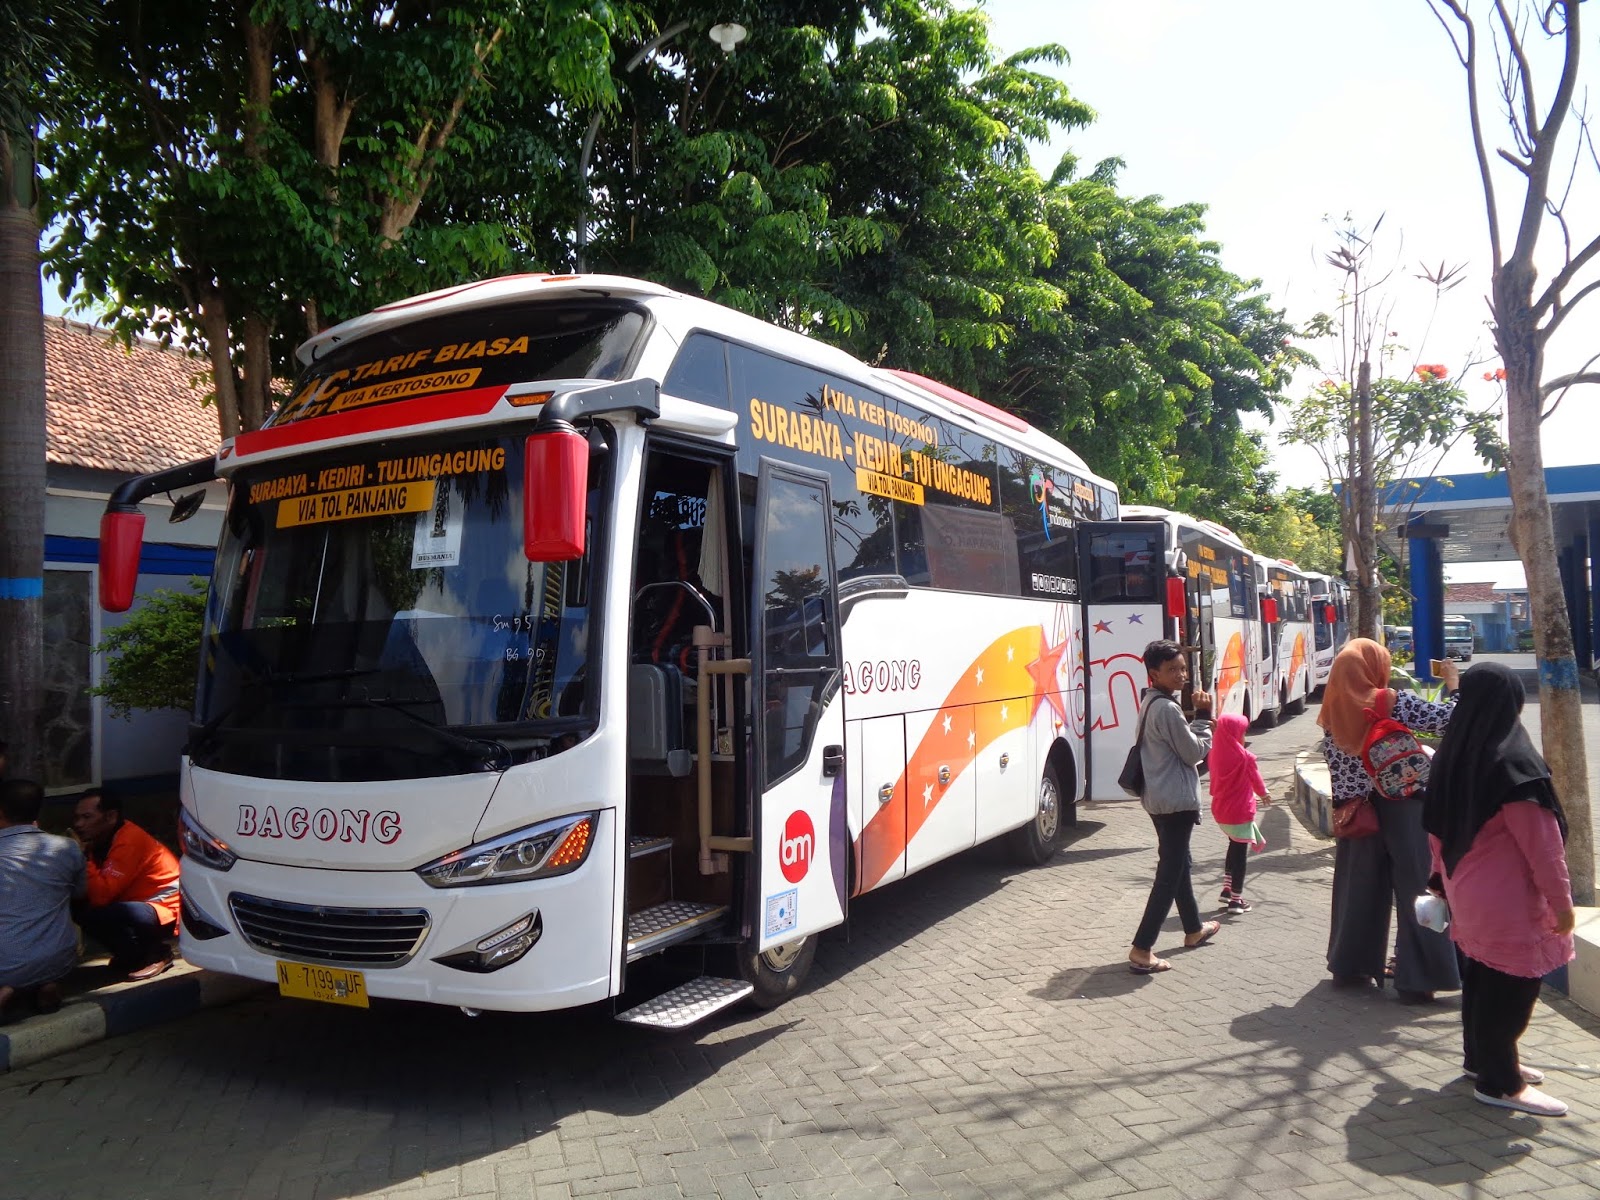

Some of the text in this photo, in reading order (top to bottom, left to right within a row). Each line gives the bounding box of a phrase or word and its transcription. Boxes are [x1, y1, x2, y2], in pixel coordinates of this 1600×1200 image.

[352, 336, 529, 382] TARIF BIASA
[341, 372, 471, 405] VIA KERTOSONO
[750, 397, 844, 462] SURABAYA
[854, 431, 903, 478] KEDIRI
[249, 473, 307, 504] SURABAYA
[318, 464, 366, 491] KEDIRI
[377, 447, 506, 483] TULUNGAGUNG
[867, 473, 878, 491] VIA
[891, 478, 915, 501] PANJANG
[299, 486, 408, 522] VIA TOL PANJANG
[236, 804, 402, 845] BAGONG
[280, 964, 362, 994] N 7199 UF
